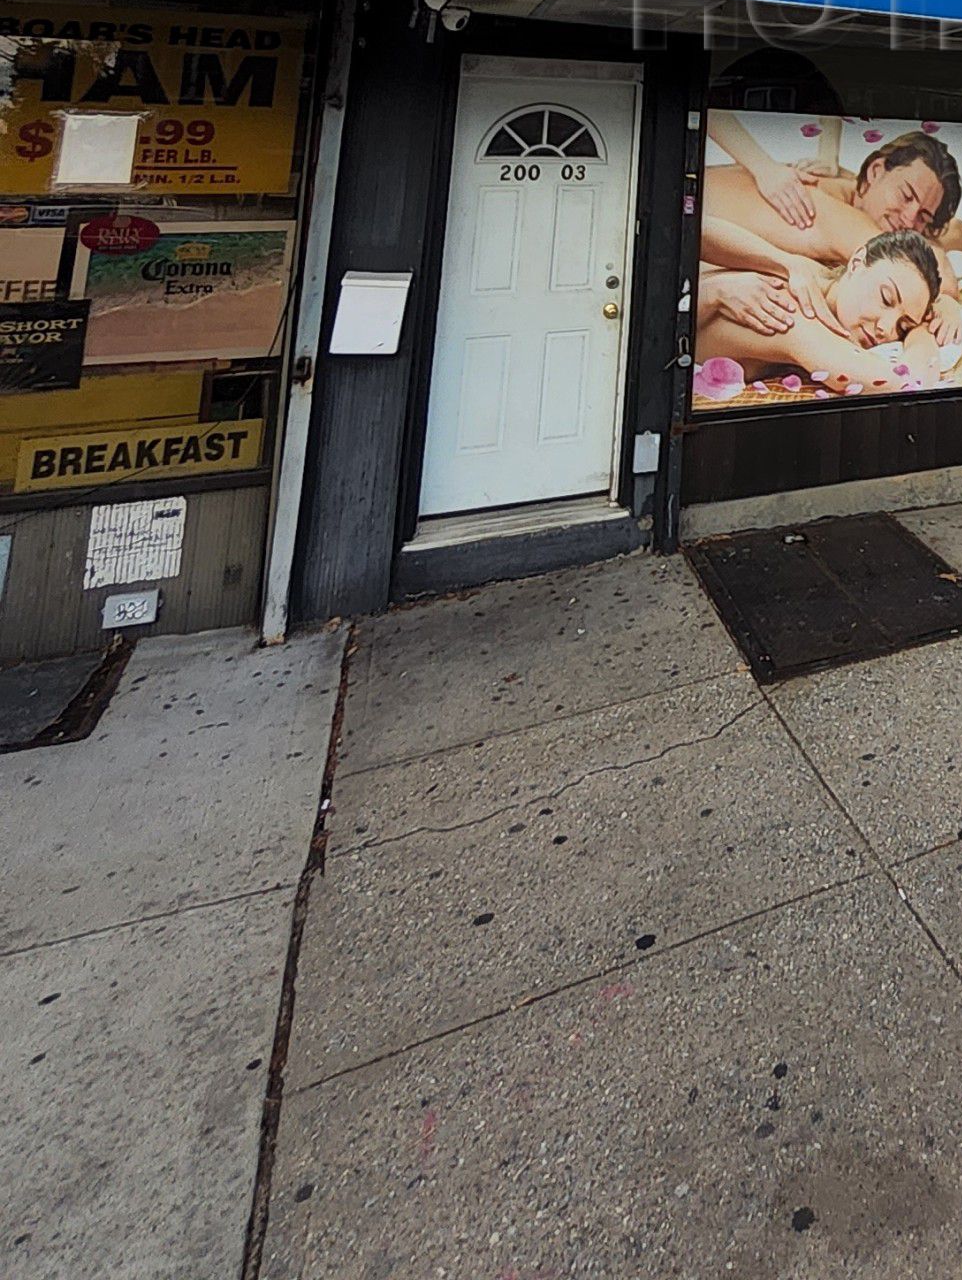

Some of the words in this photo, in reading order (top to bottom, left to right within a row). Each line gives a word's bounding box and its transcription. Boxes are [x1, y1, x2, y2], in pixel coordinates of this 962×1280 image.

[168, 25, 282, 51] HEAD
[141, 149, 178, 164] PER
[499, 164, 541, 182] 200
[560, 164, 586, 181] 03
[38, 208, 66, 218] VISA
[141, 255, 233, 283] Corona
[164, 280, 214, 295] Extra
[0, 318, 83, 333] SHORT
[30, 431, 249, 480] BREAKFAST
